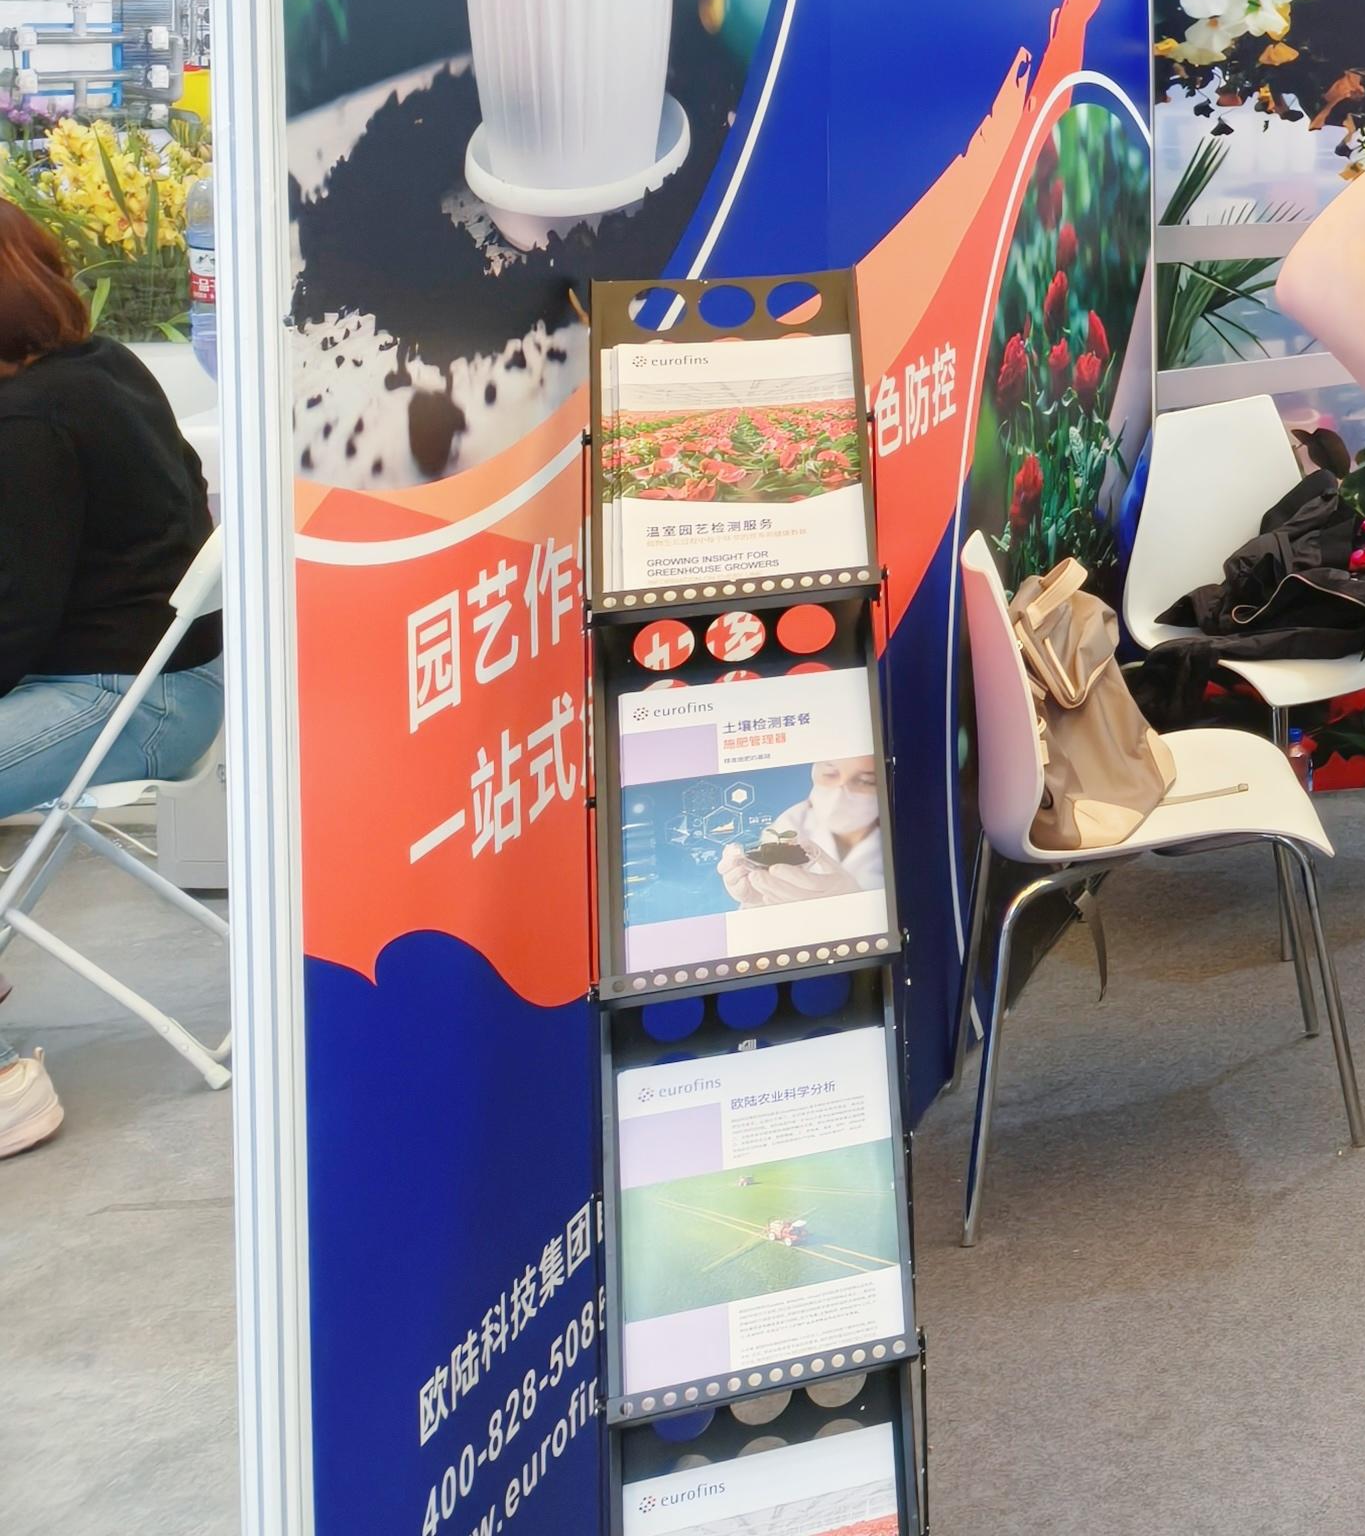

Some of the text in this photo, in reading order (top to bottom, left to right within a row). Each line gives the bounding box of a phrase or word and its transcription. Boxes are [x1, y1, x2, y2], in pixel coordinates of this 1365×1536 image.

[651, 354, 709, 367] eurofins
[865, 341, 957, 458] 色防控
[646, 518, 773, 538] 温室园艺检测服务
[646, 550, 769, 567] GROWING INSIGHT FOR
[646, 559, 780, 578] GREENHOUSE GROWERS
[407, 528, 593, 734] 园艺作
[653, 701, 714, 718] eurofins
[722, 712, 811, 735] 土壤检测套餐
[409, 677, 595, 865] 一站式
[658, 1077, 722, 1098] eurofins
[730, 1080, 836, 1111] 欧陆农业科学分析
[419, 1199, 604, 1447] 欧陆科技集团
[660, 1482, 726, 1507] eurofins
